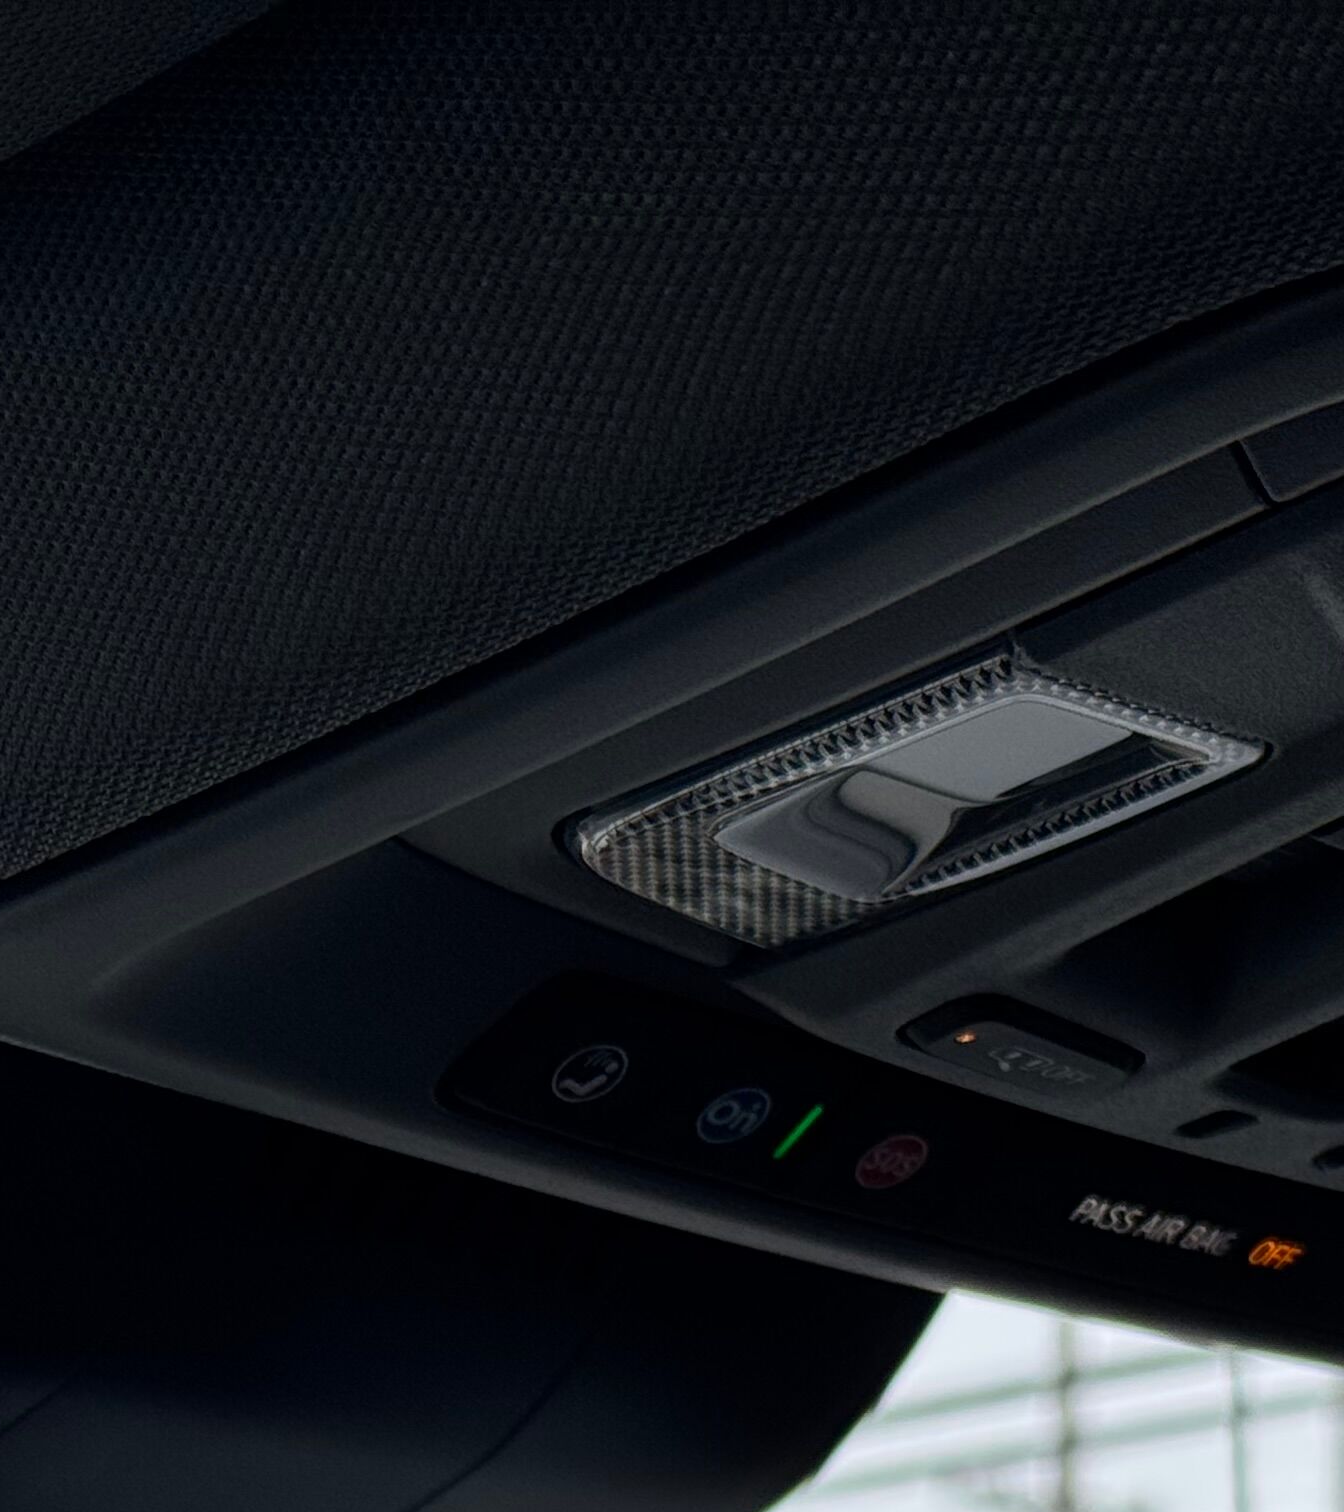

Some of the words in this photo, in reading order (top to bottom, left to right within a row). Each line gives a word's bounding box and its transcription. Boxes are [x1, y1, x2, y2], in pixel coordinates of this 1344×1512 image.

[862, 1147, 920, 1178] SOS
[1067, 1193, 1147, 1234] PASS
[1132, 1210, 1192, 1246] AIR
[1248, 1237, 1307, 1270] OFF
